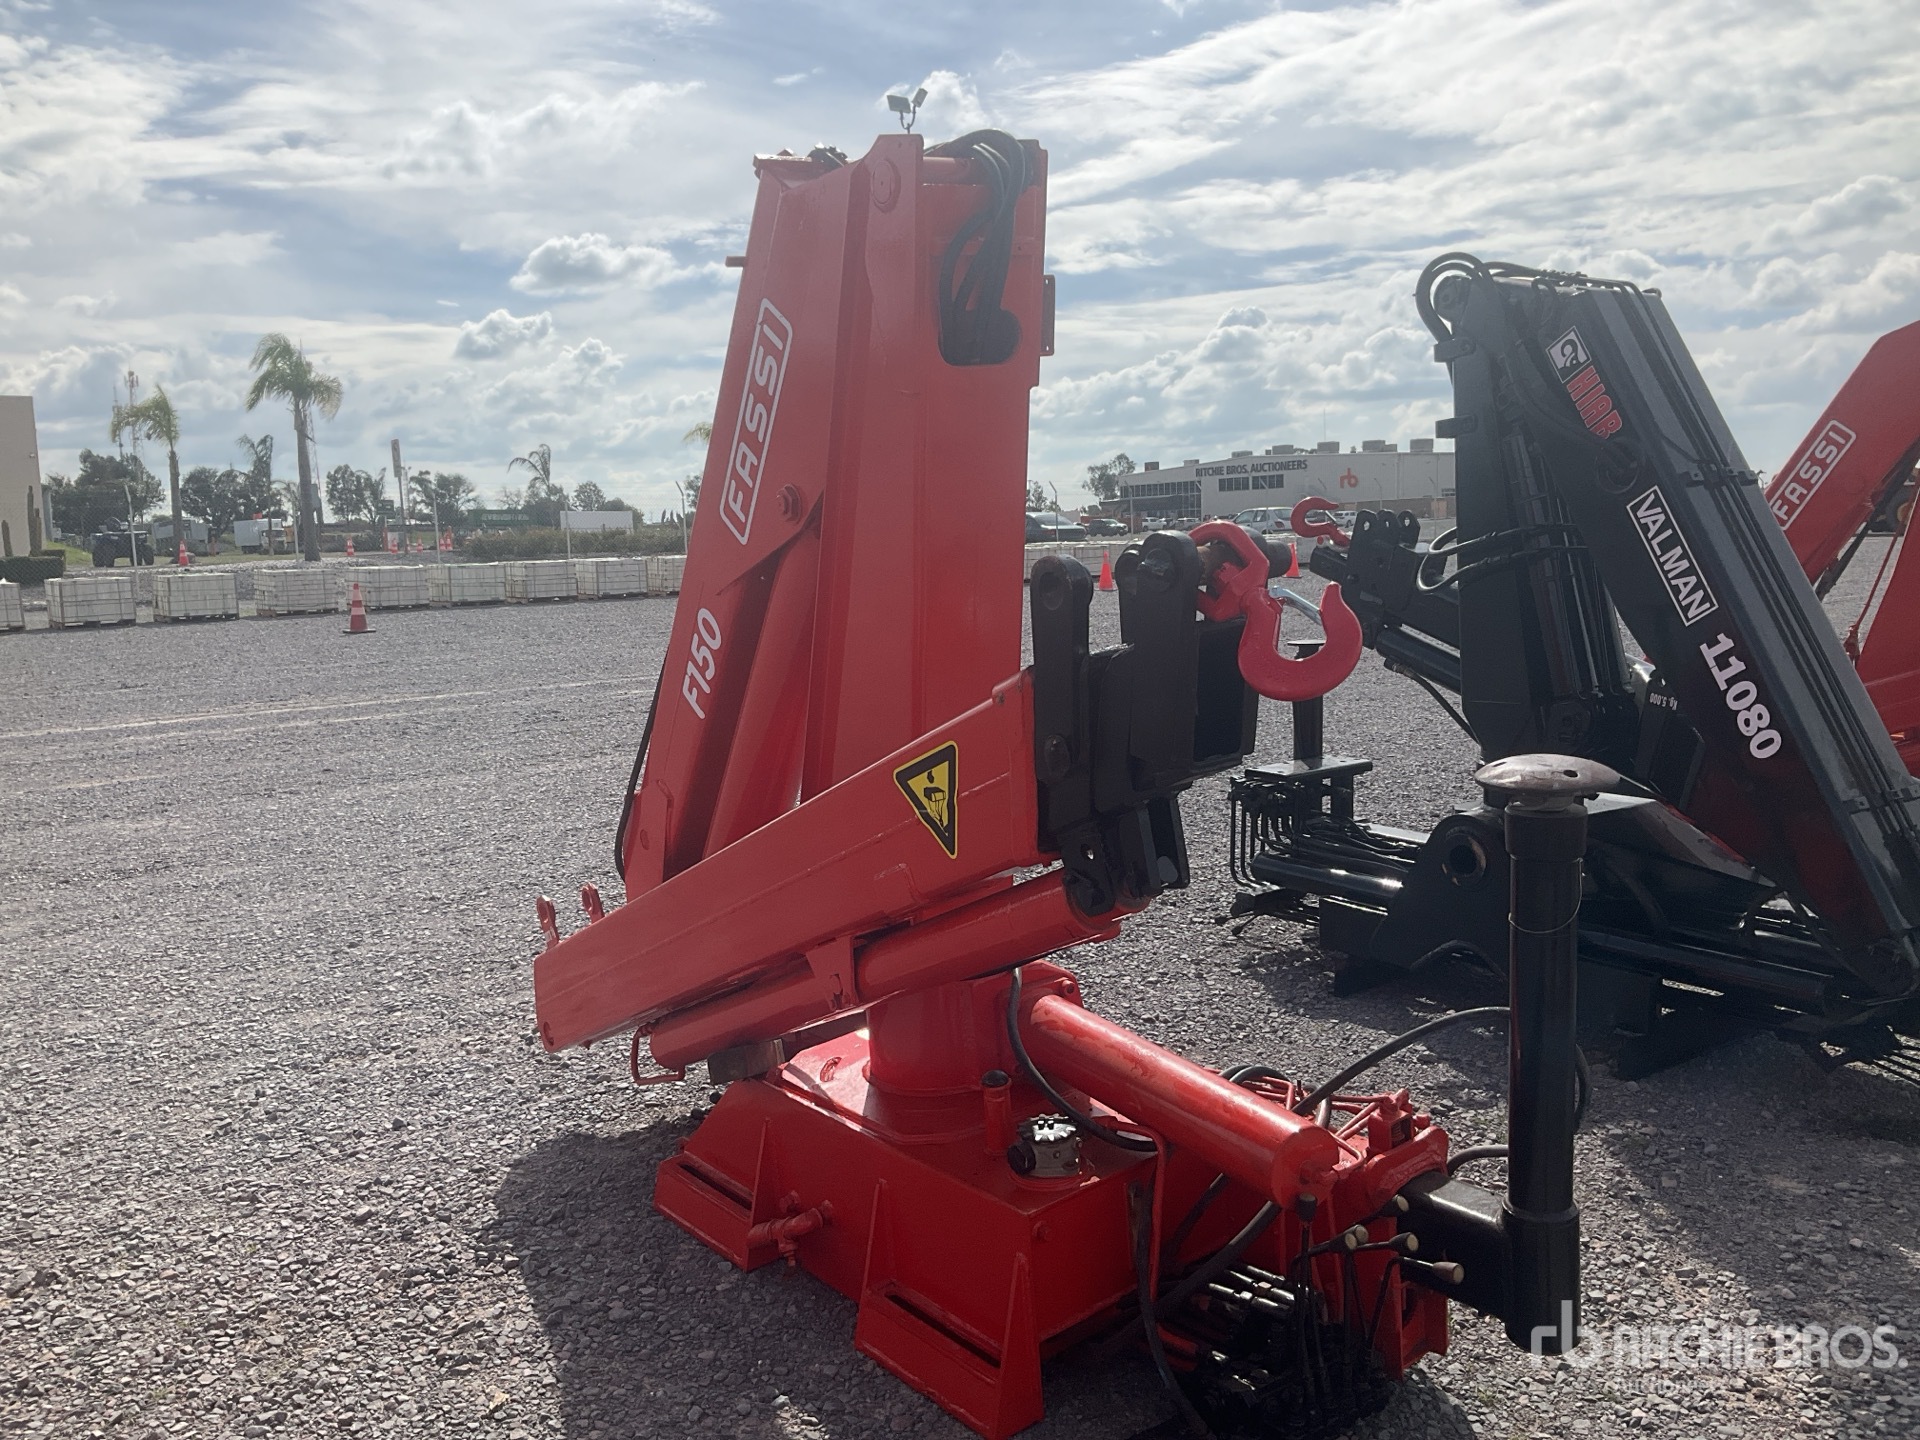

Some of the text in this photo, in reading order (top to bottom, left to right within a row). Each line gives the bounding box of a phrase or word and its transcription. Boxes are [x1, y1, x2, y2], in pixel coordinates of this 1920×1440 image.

[728, 323, 783, 523] FASSI
[1566, 365, 1623, 440] HIAB
[1196, 460, 1308, 477] RITCHIE BROS. AUCTIONEERS
[1772, 430, 1846, 521] FASSI
[1636, 493, 1710, 619] VALMAN
[682, 607, 722, 719] F150
[1700, 633, 1782, 759] 11080
